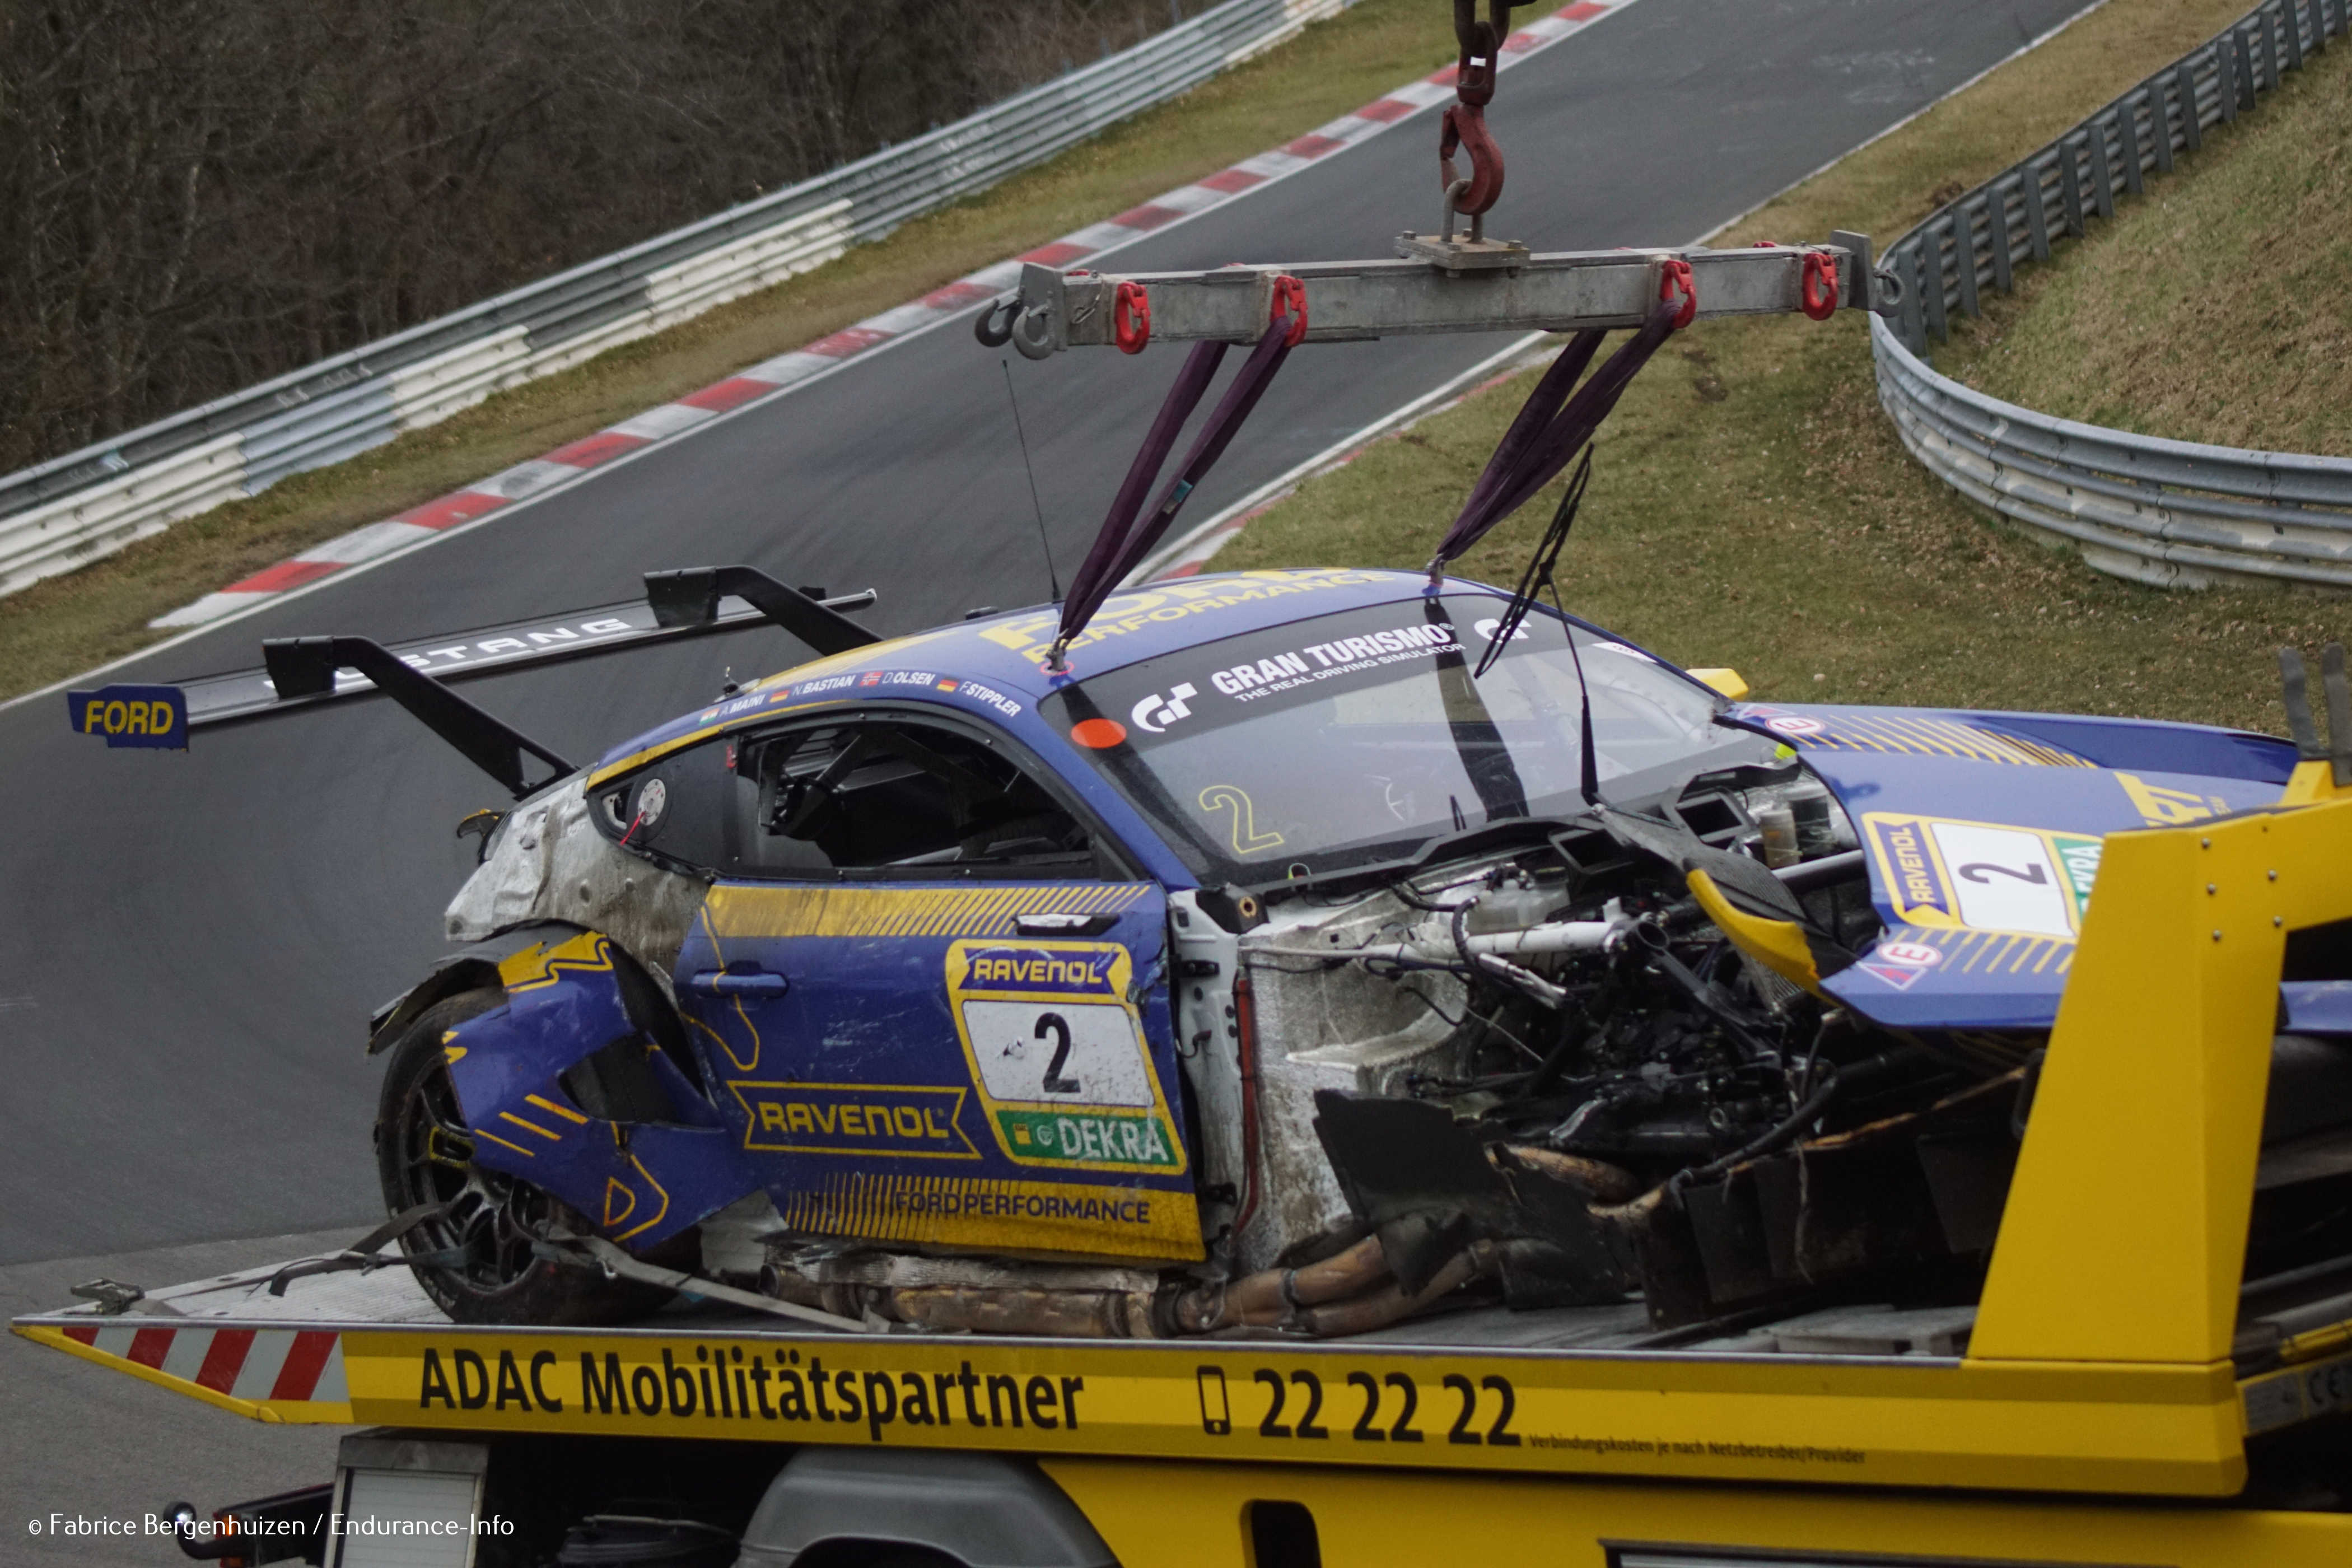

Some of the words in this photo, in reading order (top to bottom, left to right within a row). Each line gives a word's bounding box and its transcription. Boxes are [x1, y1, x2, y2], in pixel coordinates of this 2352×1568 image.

[1211, 652, 1310, 694] GRAN
[1235, 686, 1269, 703] THE
[1271, 676, 1313, 693] REAL
[1314, 659, 1378, 681] DRIVING
[1378, 642, 1467, 665] SIMULATOR
[85, 700, 174, 735] FORD
[1199, 785, 1284, 855] 2
[1890, 827, 1935, 903] RAVENOL
[1958, 862, 2048, 885] 2
[974, 958, 1103, 984] RAVENOL
[1034, 1012, 1081, 1094] 2
[758, 1101, 950, 1138] RAVENOL
[1058, 1117, 1169, 1161] DEKRA
[420, 1347, 563, 1413] ADAC
[580, 1345, 1084, 1441] Mobilitätspartner
[1253, 1368, 1329, 1439] 22
[1347, 1370, 1424, 1443] 22
[1443, 1373, 1522, 1446] 22
